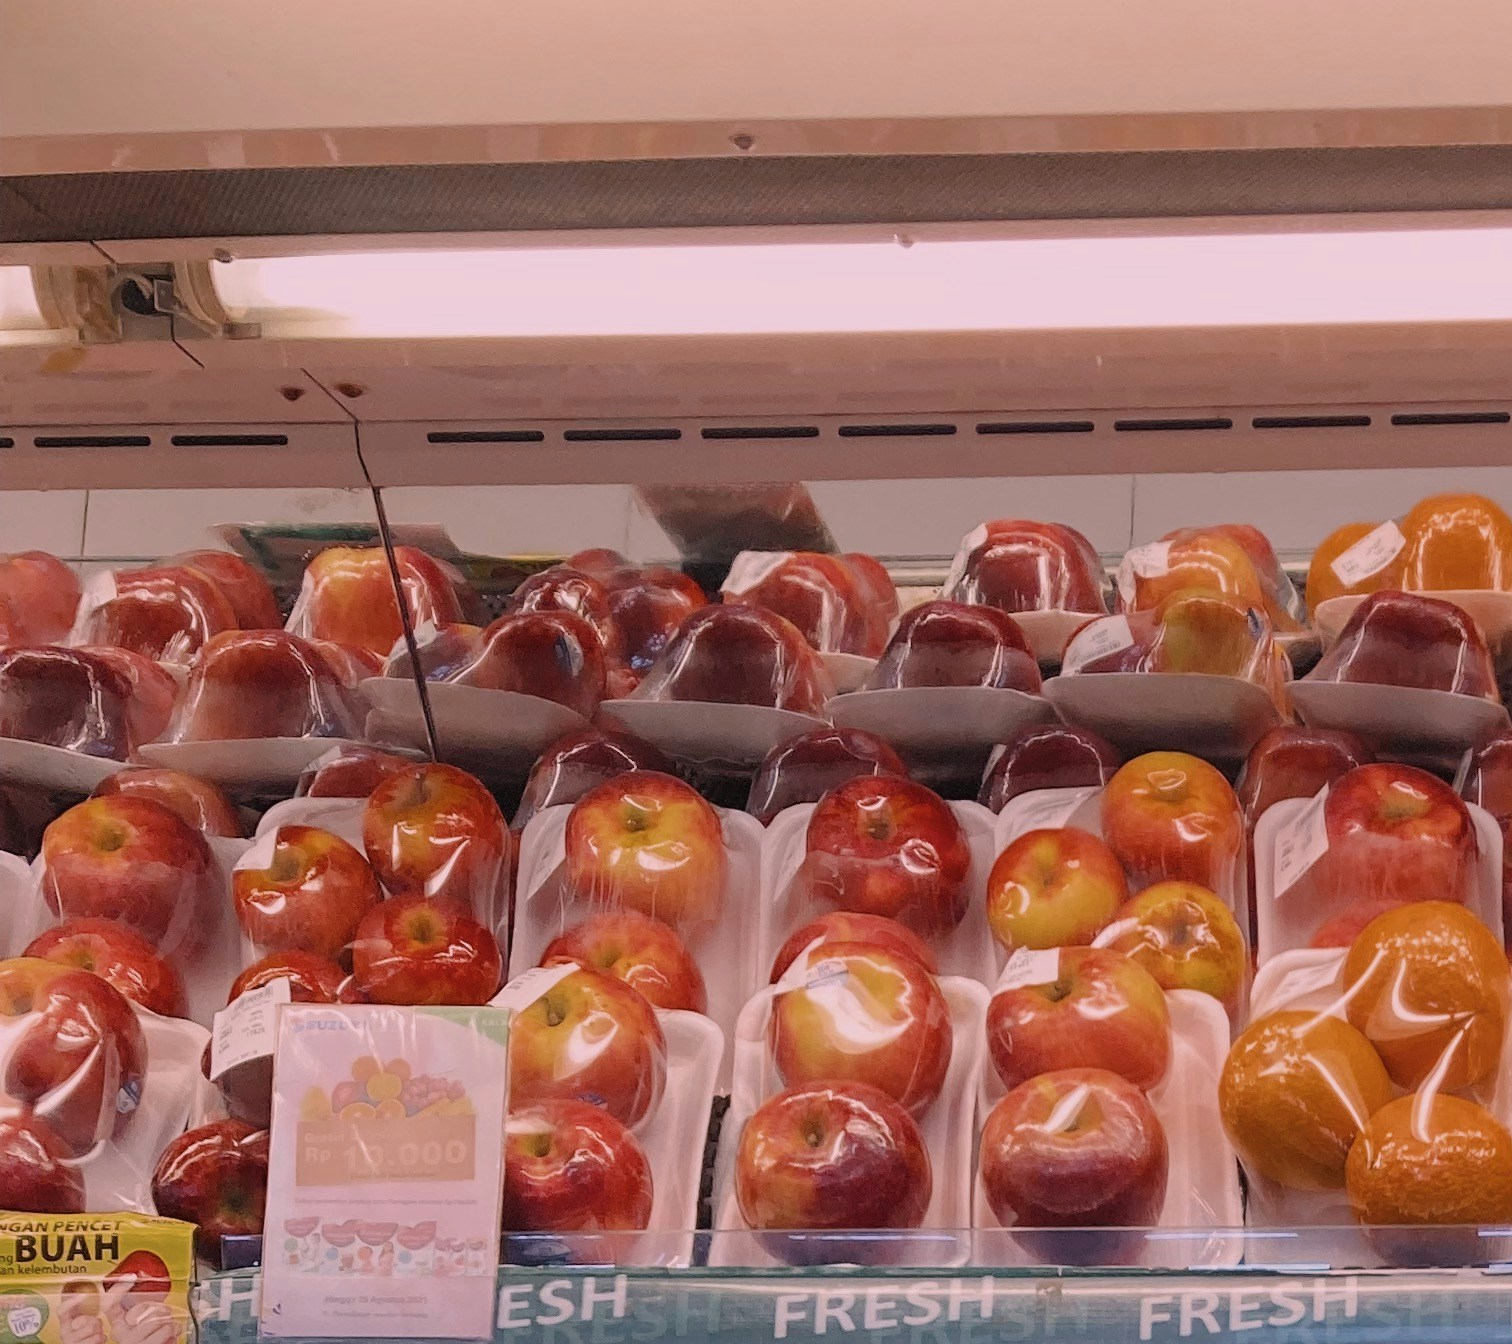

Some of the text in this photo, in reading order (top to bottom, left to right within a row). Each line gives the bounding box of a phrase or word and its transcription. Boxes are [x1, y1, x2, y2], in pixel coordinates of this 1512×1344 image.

[53, 1220, 125, 1232] PENCET
[15, 1234, 119, 1263] BUAH
[18, 1264, 87, 1275] kelembutan
[497, 1275, 628, 1331] ESH
[773, 1274, 995, 1339] FRESH
[1138, 1276, 1358, 1340] FRESH
